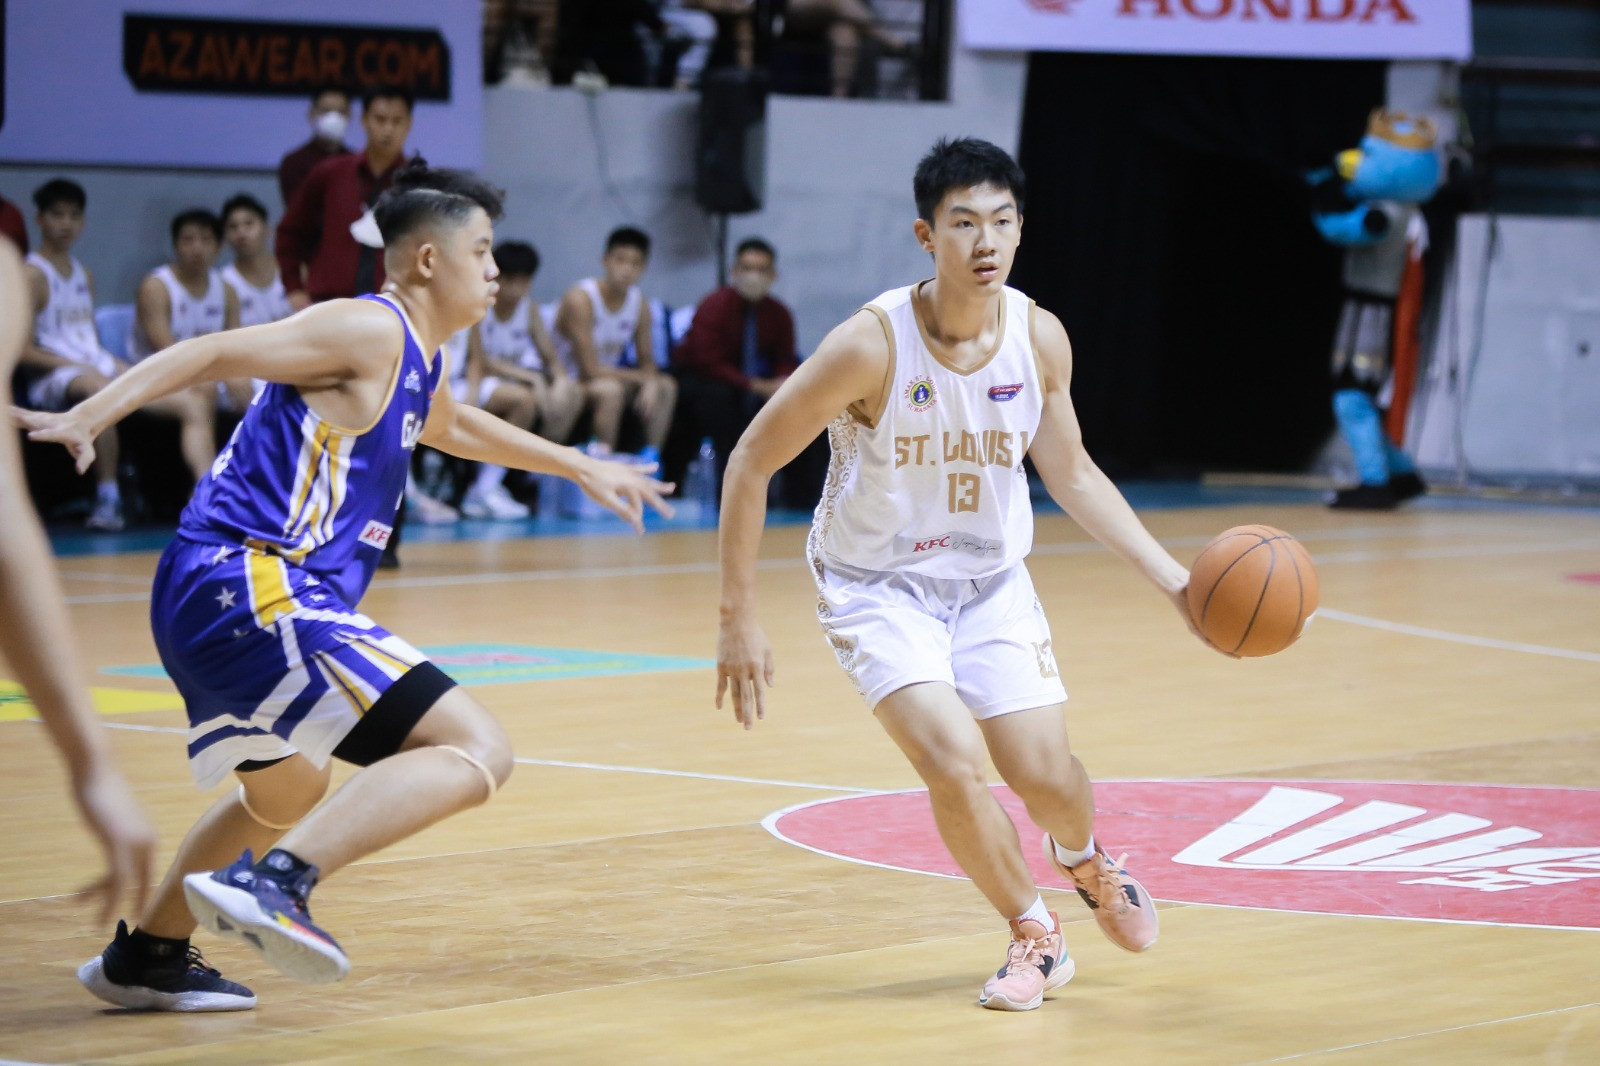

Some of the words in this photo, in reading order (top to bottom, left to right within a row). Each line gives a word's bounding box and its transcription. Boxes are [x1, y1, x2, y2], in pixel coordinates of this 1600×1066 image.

[894, 434, 936, 470] ST.
[943, 429, 1014, 469] LOUIS
[947, 473, 981, 513] 13
[365, 527, 391, 545] KF
[912, 536, 950, 553] KFC
